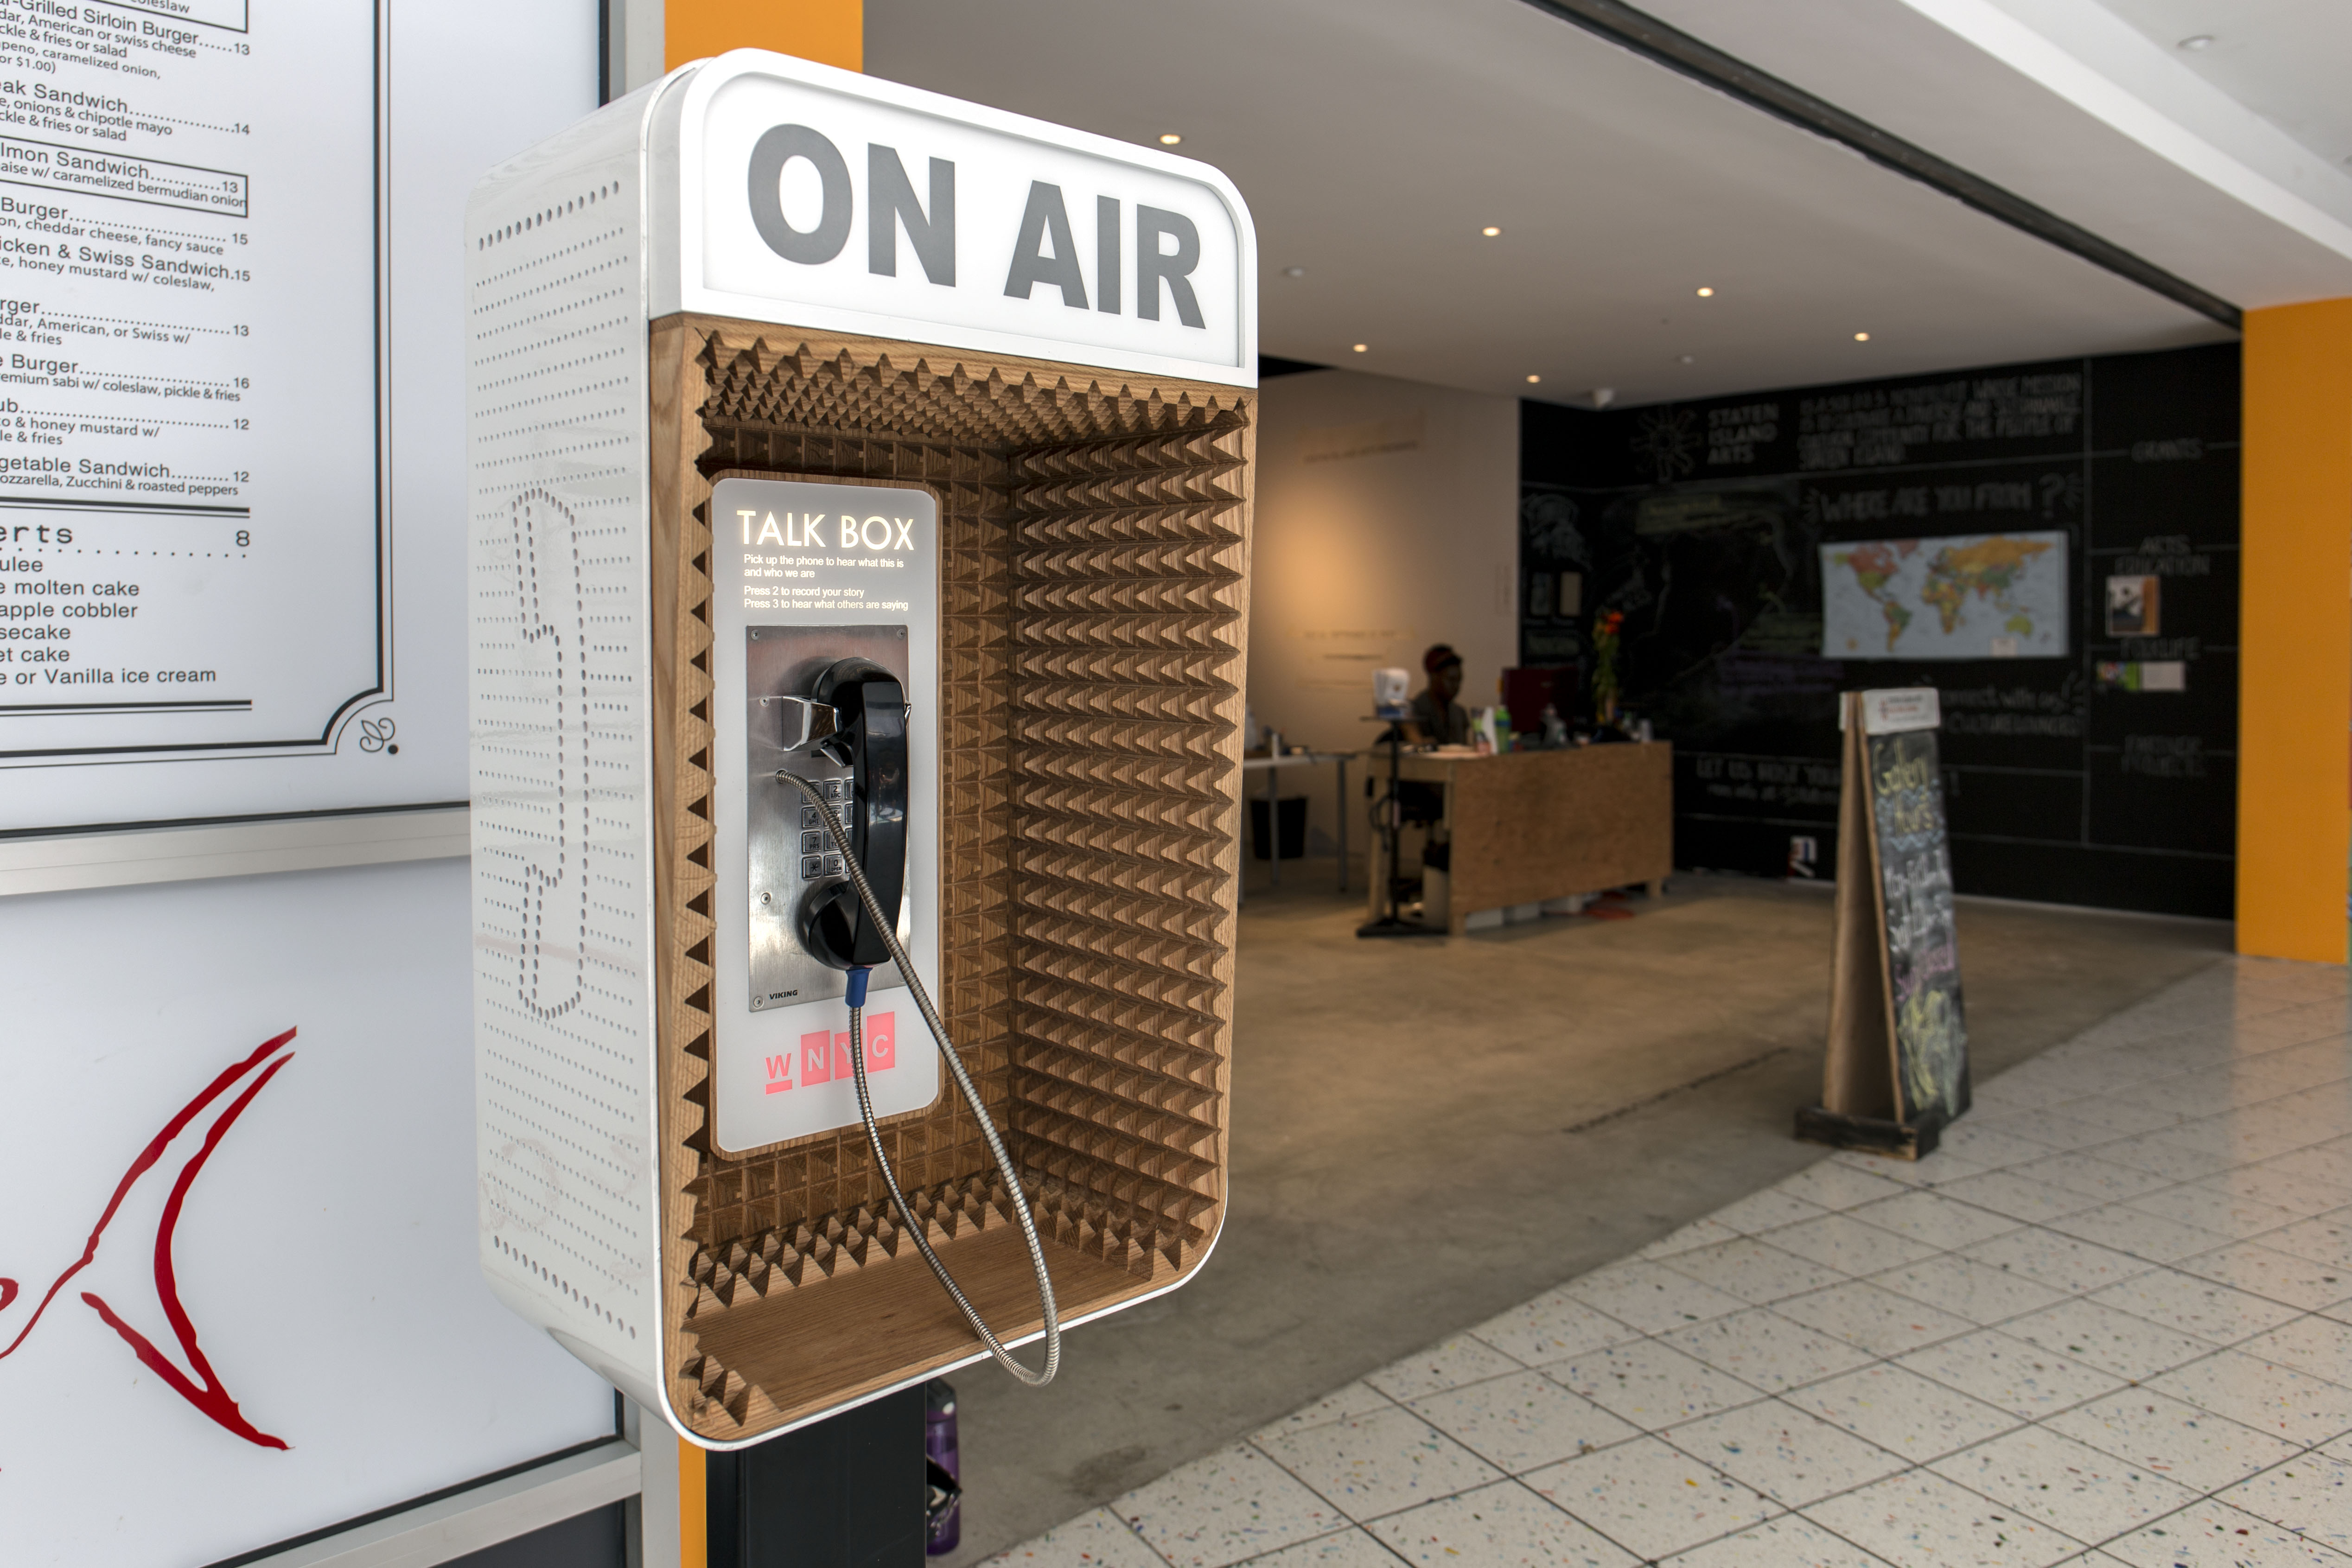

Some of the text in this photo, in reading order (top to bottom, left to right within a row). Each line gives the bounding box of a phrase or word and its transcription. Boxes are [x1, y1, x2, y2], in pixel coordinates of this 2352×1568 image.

[0, 8, 197, 58] dar, American or swiss cheese
[0, 23, 127, 58] ckle & fries or salad
[83, 8, 250, 56] Sirloin Burger 13
[0, 55, 56, 75] or $1.00)
[1, 41, 161, 80] peno, caramelized onion,
[0, 79, 26, 96] ak
[234, 122, 250, 135] 14
[13, 100, 61, 116] onions
[64, 106, 75, 118] &
[78, 109, 133, 128] chipotle
[136, 121, 173, 136] mayo
[29, 115, 39, 127] &
[42, 116, 72, 132] fries
[74, 125, 89, 135] or
[92, 127, 127, 141] salad
[0, 142, 48, 164] lmon
[223, 181, 238, 193] 13
[0, 163, 246, 207] aise w/ caramelized bermudian onion
[0, 217, 224, 255] on, cheddar cheese, fancy sauce
[747, 123, 1206, 330] ON AIR
[232, 232, 249, 246] 15
[57, 243, 71, 259] &
[79, 246, 134, 267] Swiss
[235, 269, 251, 282] 15
[19, 256, 215, 293] honey mustard w/ coleslaw,
[16, 330, 27, 342] &
[31, 331, 62, 345] fries
[37, 318, 109, 338] American,
[113, 328, 128, 338] or
[132, 327, 169, 342] Swiss
[173, 333, 191, 344] w/
[233, 324, 249, 337] 13
[0, 373, 241, 402] emium sabi w/ coleslaw, pickle & fries
[234, 377, 250, 389] 16
[15, 416, 160, 438] & honey mustard w/
[233, 418, 249, 431] 12
[17, 431, 27, 443] &
[32, 431, 63, 446] fries
[0, 456, 71, 473] getable
[233, 471, 249, 483] 12
[0, 474, 239, 496] ozzarella, Zucchini & roasted peppers
[236, 529, 250, 548] 8
[737, 510, 914, 550] TALK BOX
[0, 556, 44, 573] ulee
[744, 554, 904, 567] Pick up the phone to hear what this is
[744, 567, 761, 577] and
[764, 568, 782, 577] who
[785, 569, 798, 578] we
[14, 579, 84, 595] molten
[92, 580, 140, 597] cake
[744, 586, 864, 598] Press 2 to record your story
[0, 602, 138, 621] apple cobbler
[744, 599, 908, 611] Press 3 to hear what others are saying
[0, 624, 71, 640] secake
[20, 647, 70, 663] cake
[15, 672, 37, 685] or
[44, 668, 115, 684] Vanilla
[121, 668, 150, 683] ice
[156, 670, 216, 683] cream
[769, 990, 798, 1000] VIKING
[765, 1035, 888, 1079] WNYC
